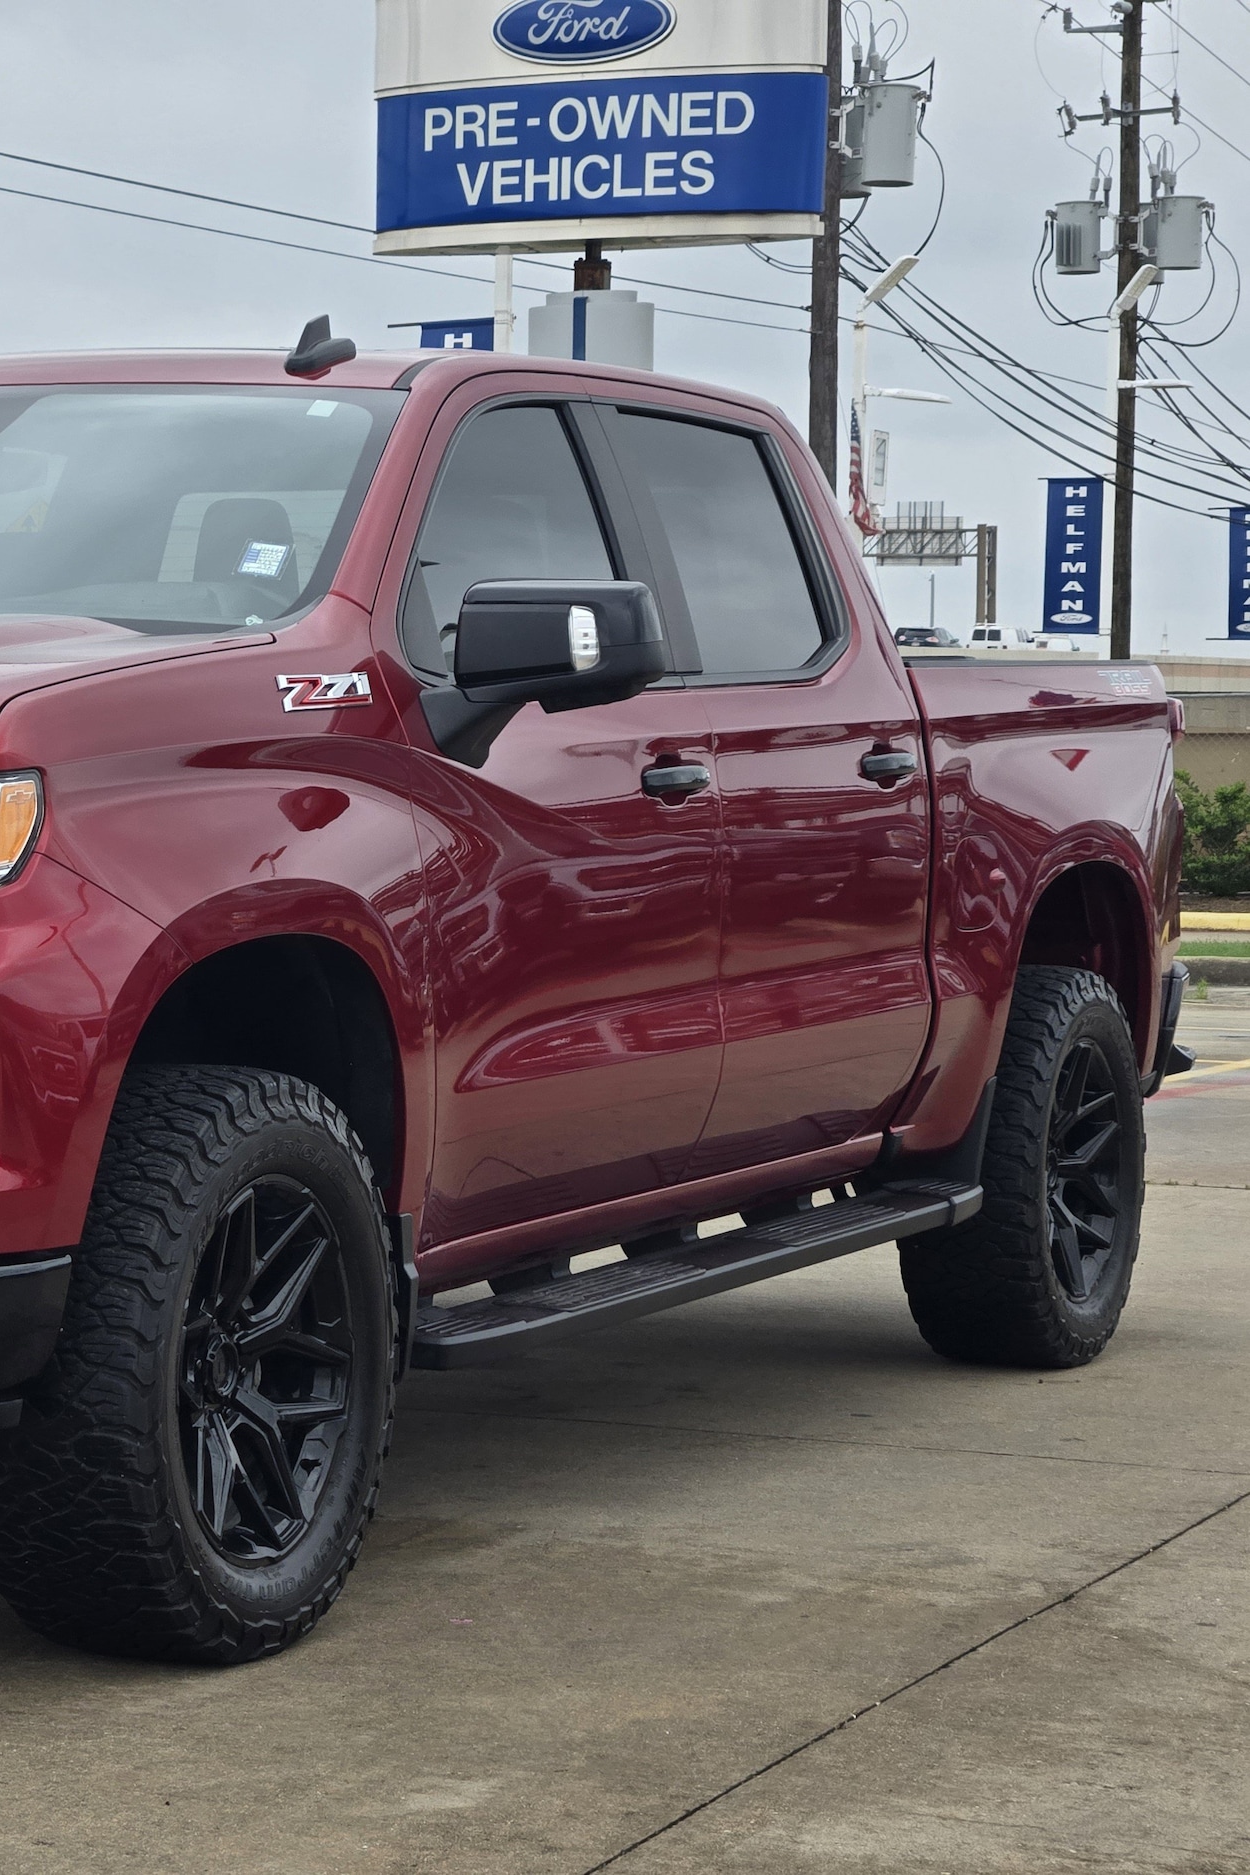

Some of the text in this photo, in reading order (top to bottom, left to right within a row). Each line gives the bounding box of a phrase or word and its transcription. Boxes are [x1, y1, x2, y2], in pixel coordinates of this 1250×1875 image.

[527, 0, 629, 45] Ford
[424, 90, 755, 152] PRE-OWNED
[456, 150, 715, 206] VEHICLES
[1060, 486, 1088, 611] HELFMAN
[1060, 614, 1083, 622] Ford
[275, 671, 373, 712] Z71
